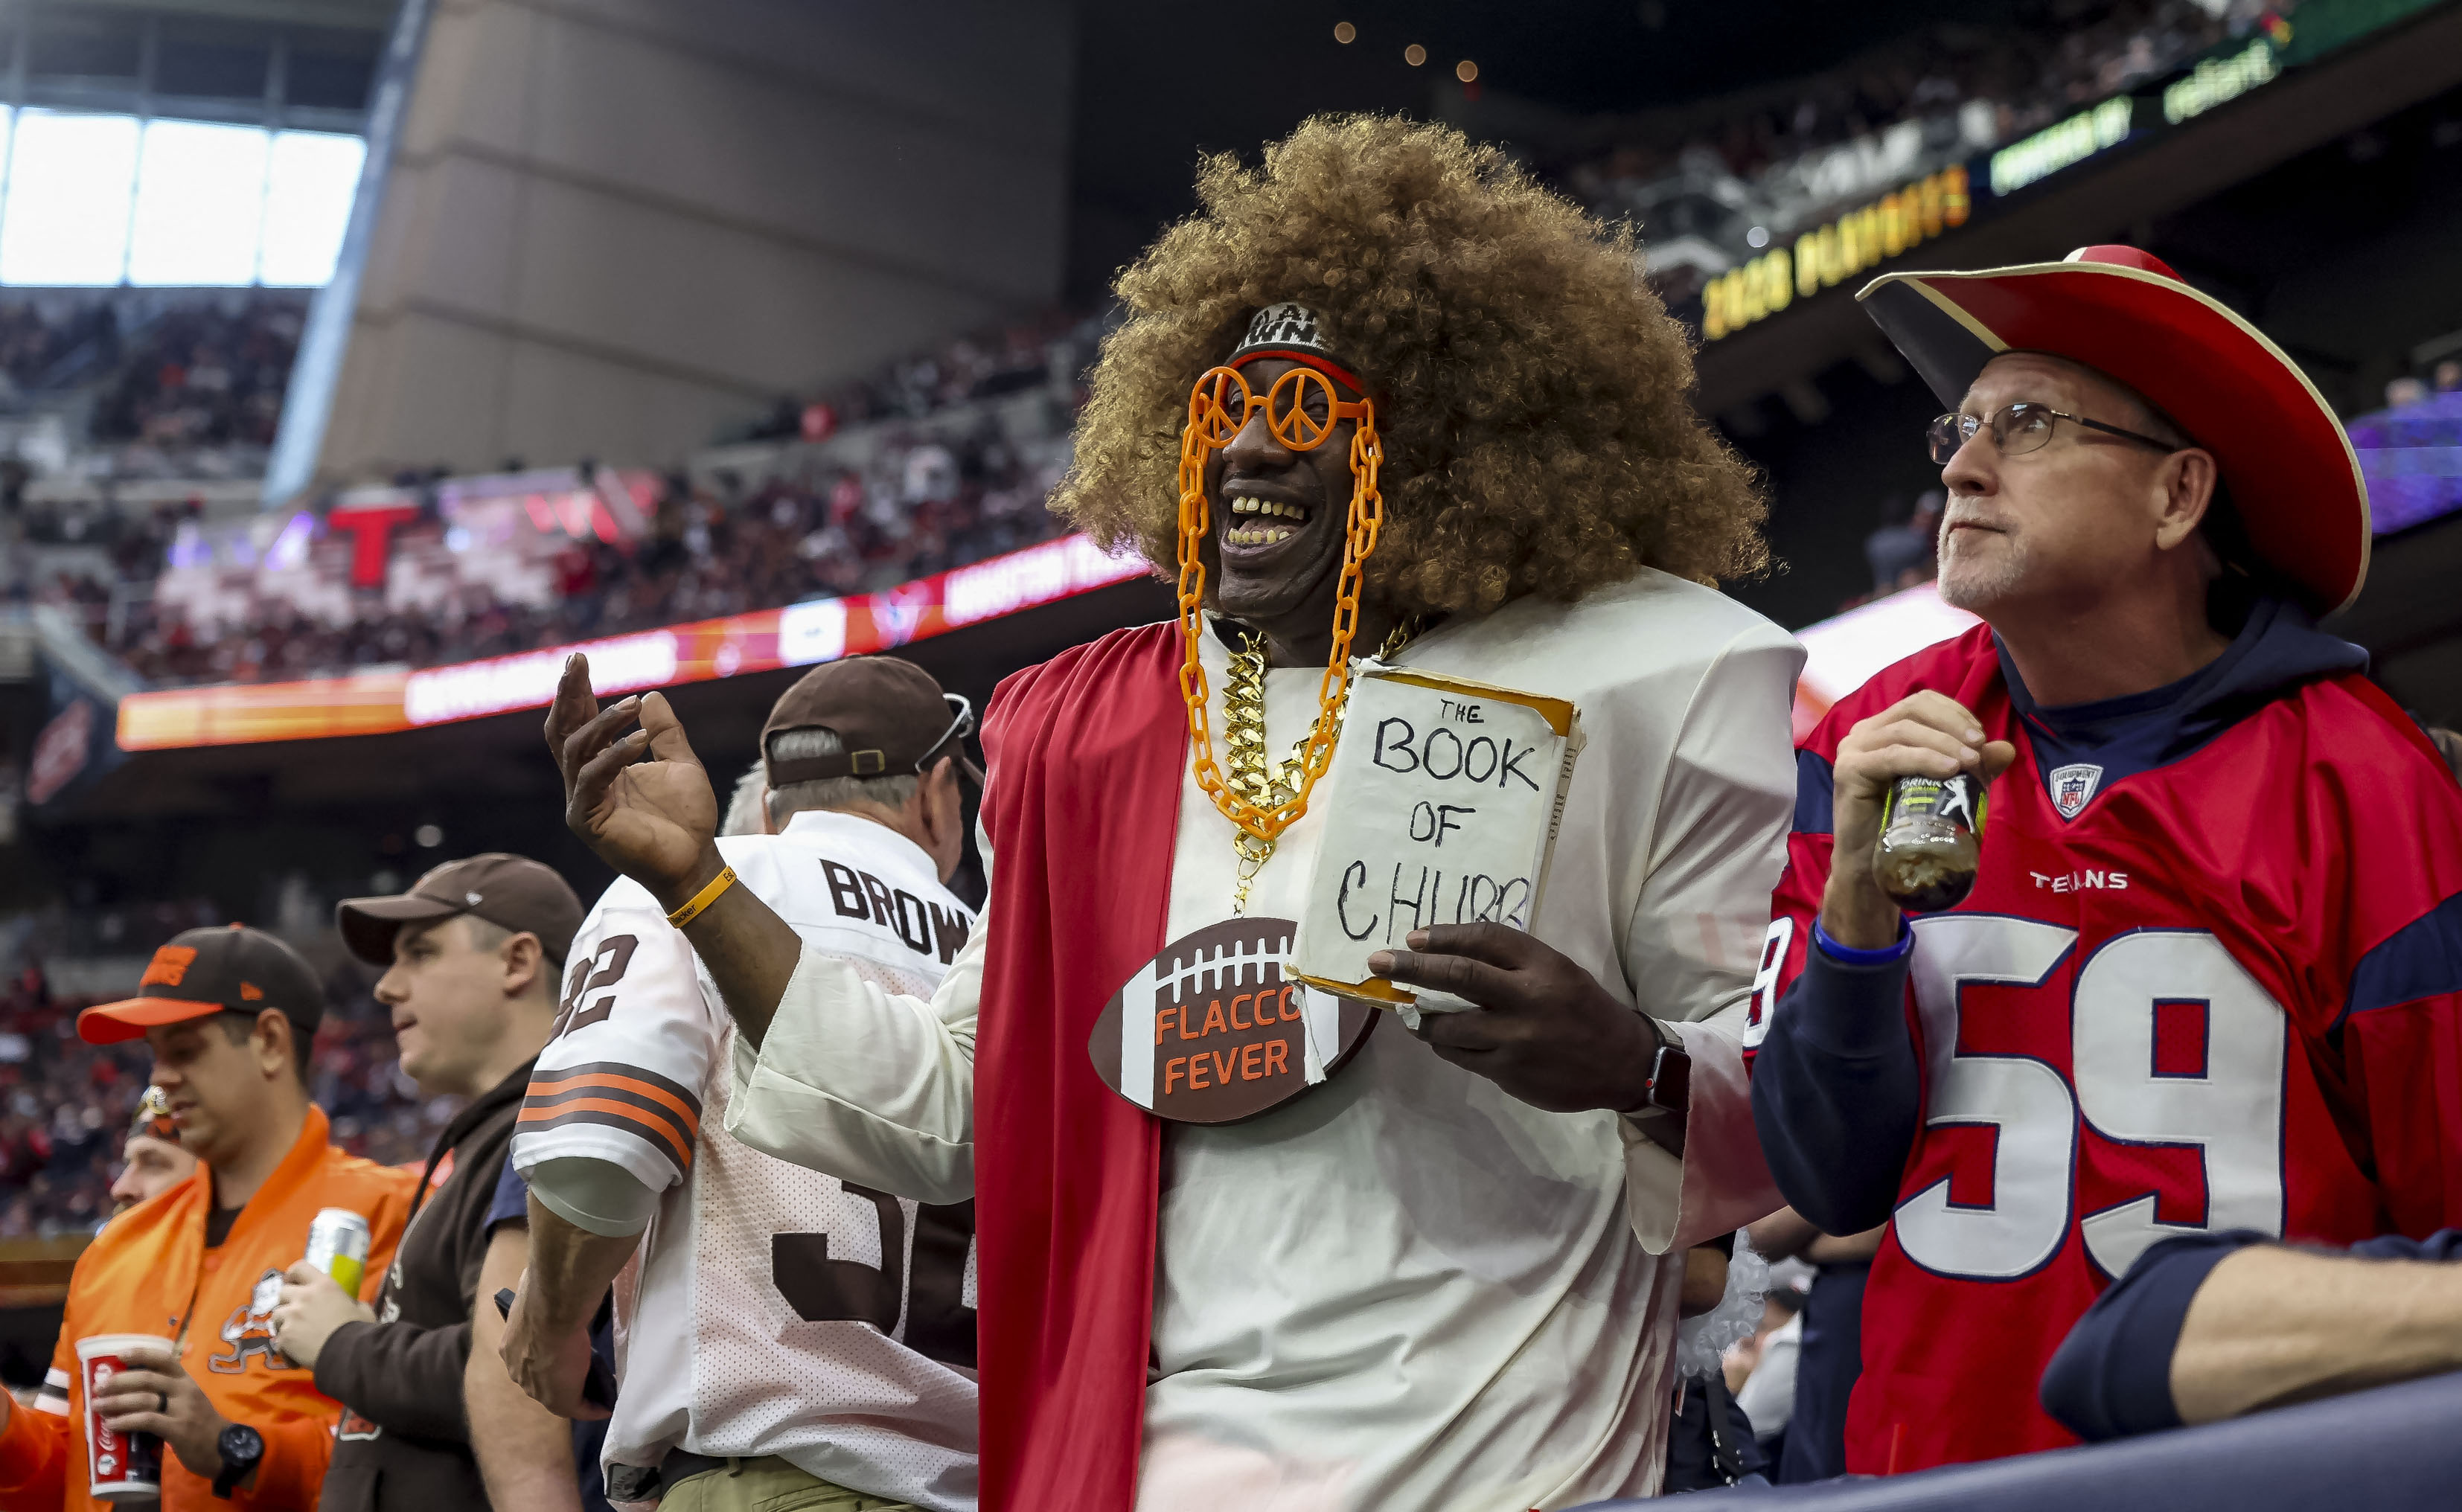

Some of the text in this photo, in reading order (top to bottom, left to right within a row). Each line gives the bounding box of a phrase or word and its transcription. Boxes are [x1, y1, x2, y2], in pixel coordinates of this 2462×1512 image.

[1441, 698, 1484, 723] THE
[1373, 717, 1540, 792] BOOK
[1410, 801, 1476, 848] OF
[2062, 792, 2081, 806] NFL
[819, 859, 974, 965] BROW
[1165, 1040, 1288, 1095] FEVER
[1894, 912, 2286, 1281] 59
